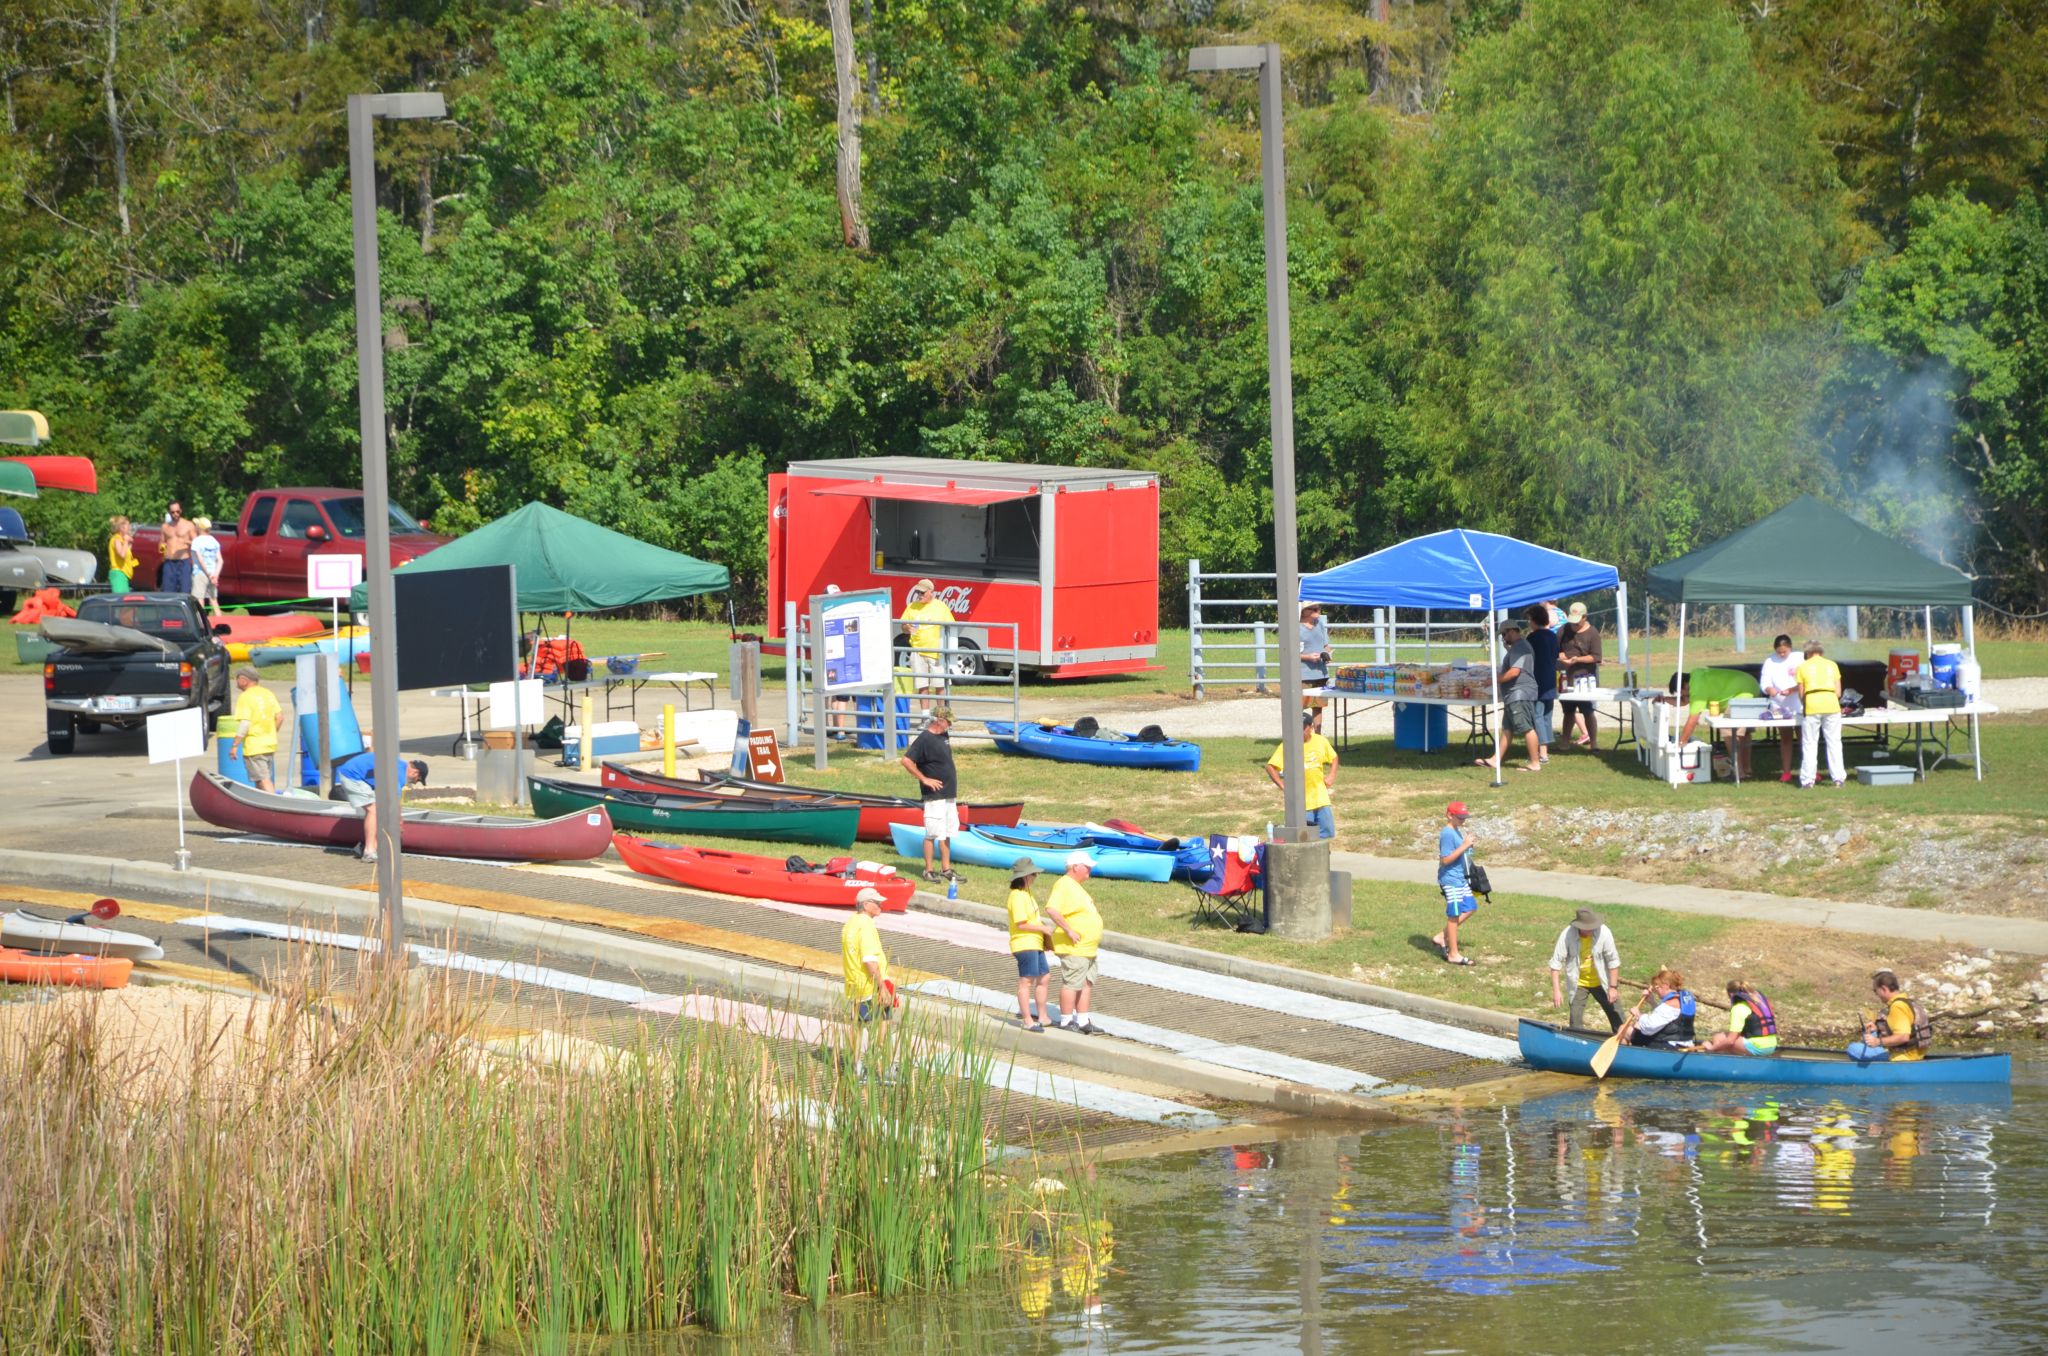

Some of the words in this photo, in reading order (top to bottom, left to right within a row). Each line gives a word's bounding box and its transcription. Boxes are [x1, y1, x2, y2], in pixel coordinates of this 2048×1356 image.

[906, 585, 972, 613] CCola
[750, 735, 773, 746] PADDLING
[756, 746, 771, 755] TRAIL
